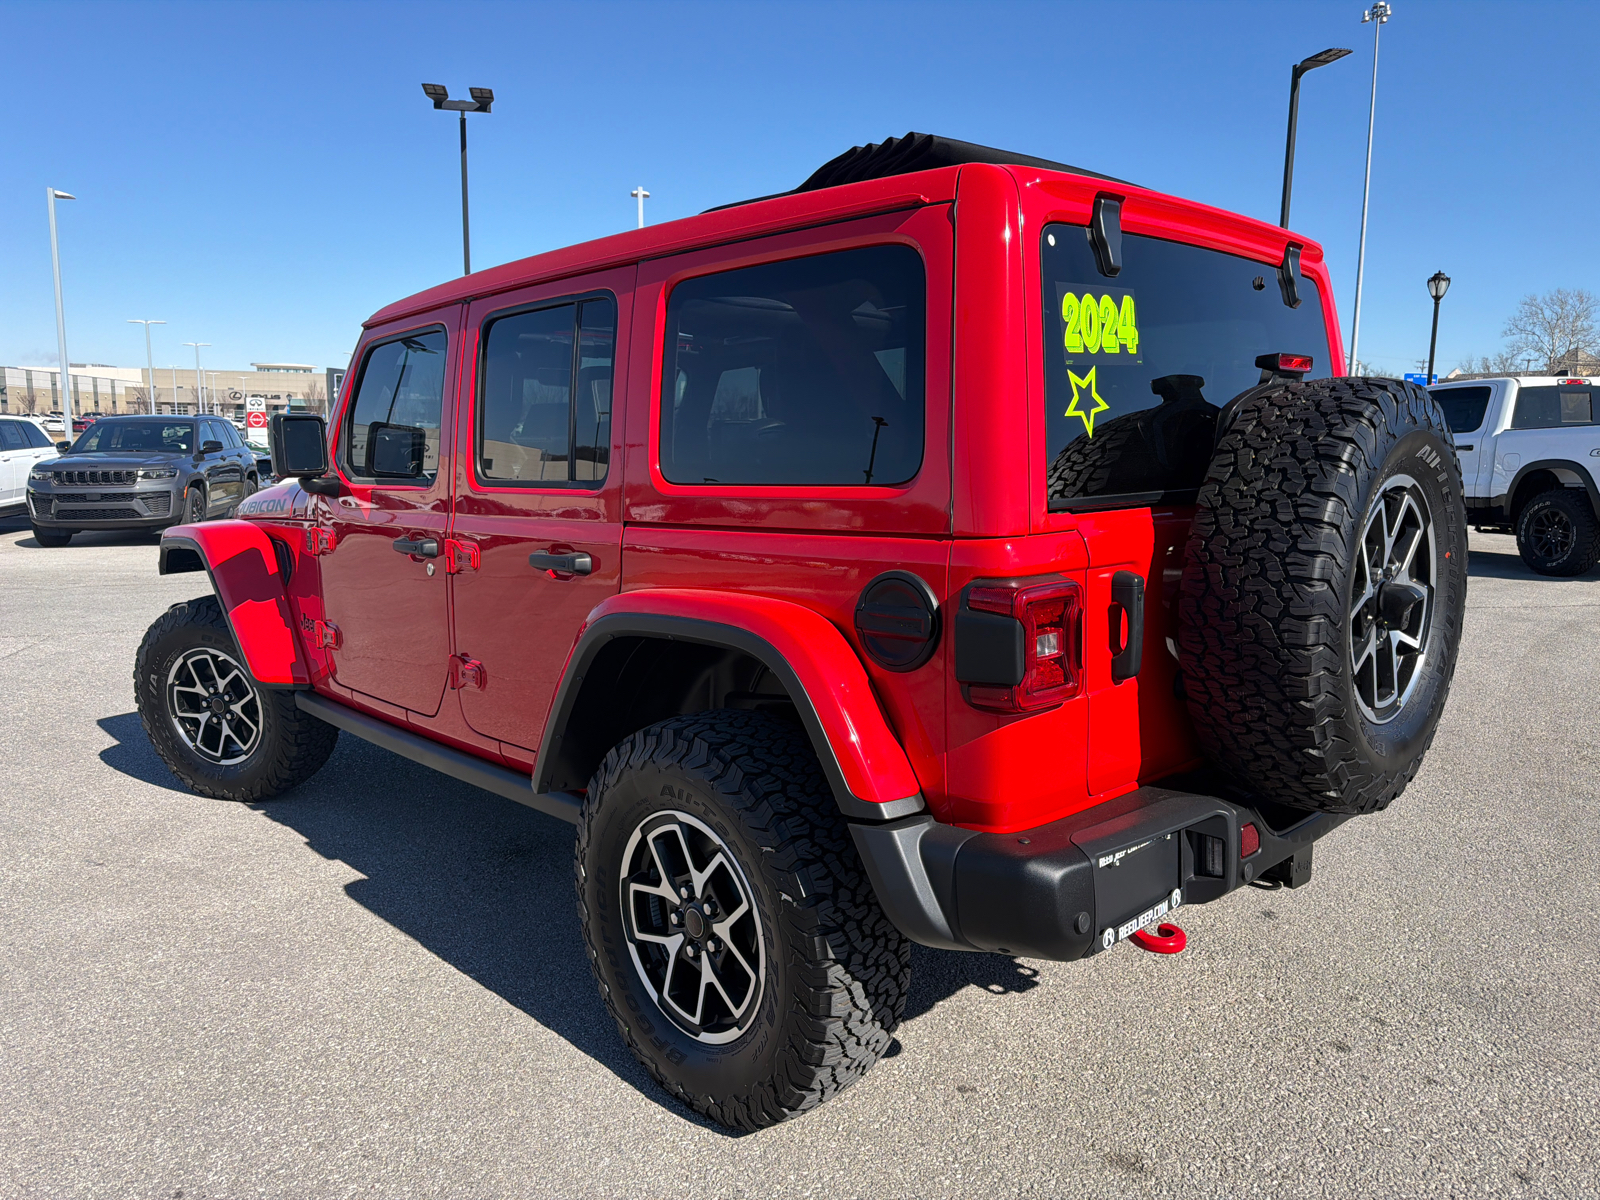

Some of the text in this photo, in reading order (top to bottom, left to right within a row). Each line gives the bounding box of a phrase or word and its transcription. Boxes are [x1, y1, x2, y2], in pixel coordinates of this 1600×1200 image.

[1062, 292, 1139, 354] 2024
[1118, 900, 1168, 940] REEDJEEP.COM
[594, 864, 689, 1067] BFGoodrich
